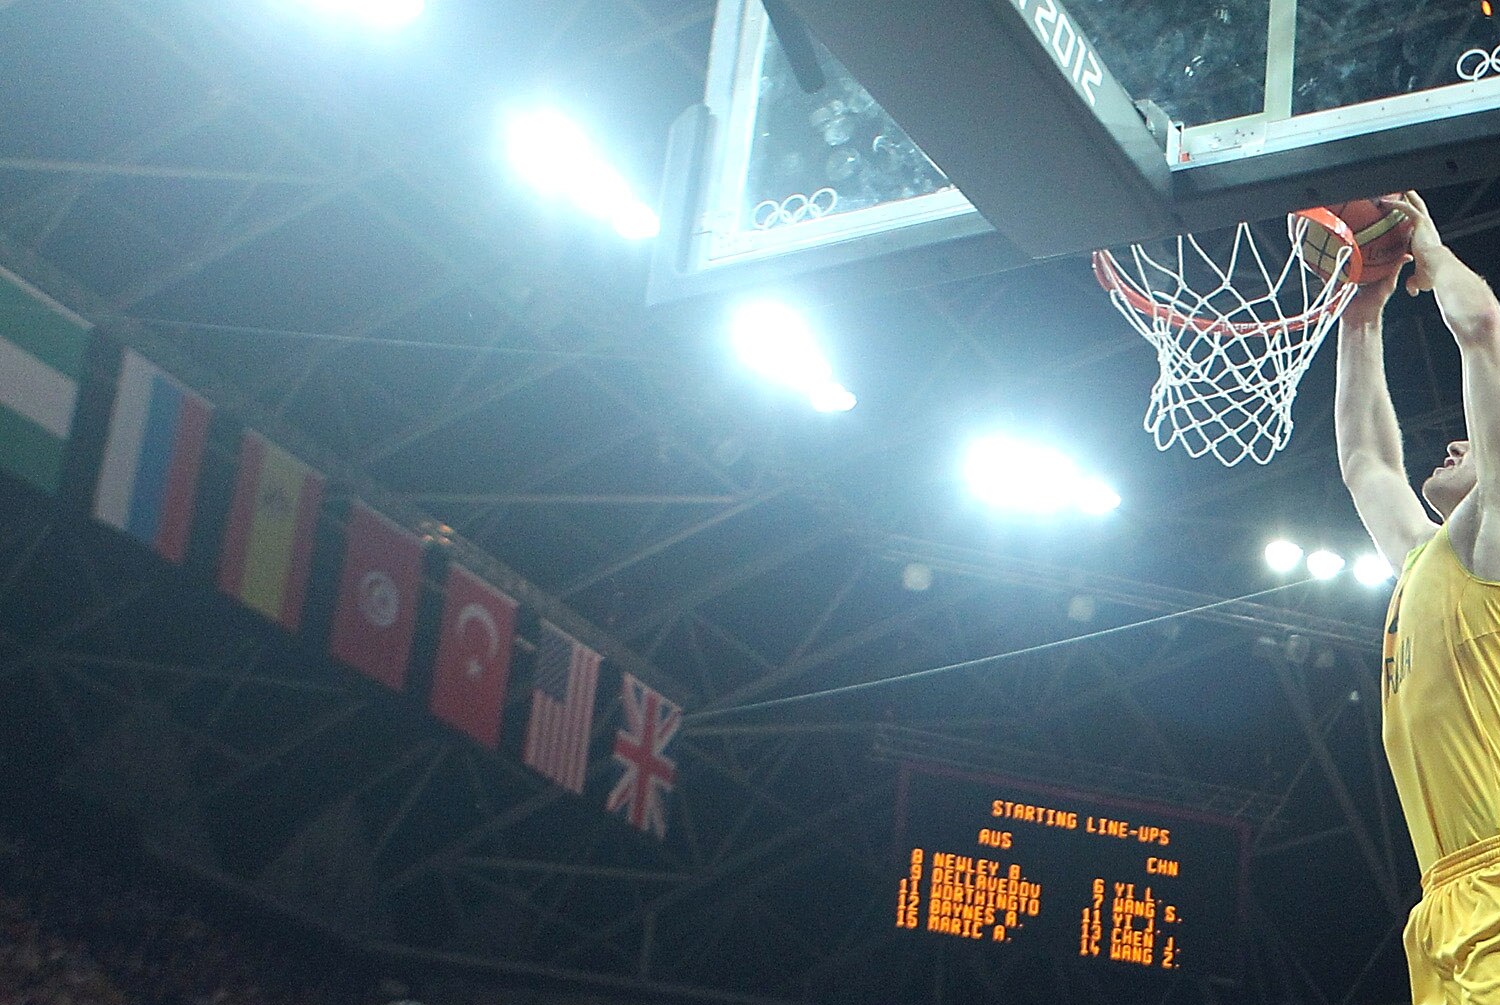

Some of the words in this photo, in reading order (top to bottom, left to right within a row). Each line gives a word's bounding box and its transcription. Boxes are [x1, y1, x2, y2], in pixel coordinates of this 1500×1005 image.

[1035, 0, 1103, 106] 2012
[991, 799, 1078, 830] STARTING
[1086, 816, 1170, 845] LINE-UPS
[978, 829, 1013, 849] AUS
[910, 864, 923, 880] 9
[932, 852, 999, 876] NEWLEY
[1146, 857, 1179, 877] CHN
[899, 878, 920, 896] 11
[930, 883, 1040, 916] WORTHINGTO
[1092, 878, 1105, 894] 6
[1114, 882, 1135, 899] YI
[897, 893, 920, 912] 12
[928, 898, 995, 926] BAYNES
[1082, 907, 1102, 925] 11
[1112, 912, 1133, 930] YI
[1093, 894, 1104, 909] 7
[1112, 897, 1155, 919] WANG
[896, 908, 919, 929] 15
[927, 914, 983, 940] MARIC
[1081, 922, 1101, 941] 13
[1110, 927, 1154, 949] CHEN
[1079, 939, 1101, 957] 14
[1110, 943, 1153, 965] WANG
